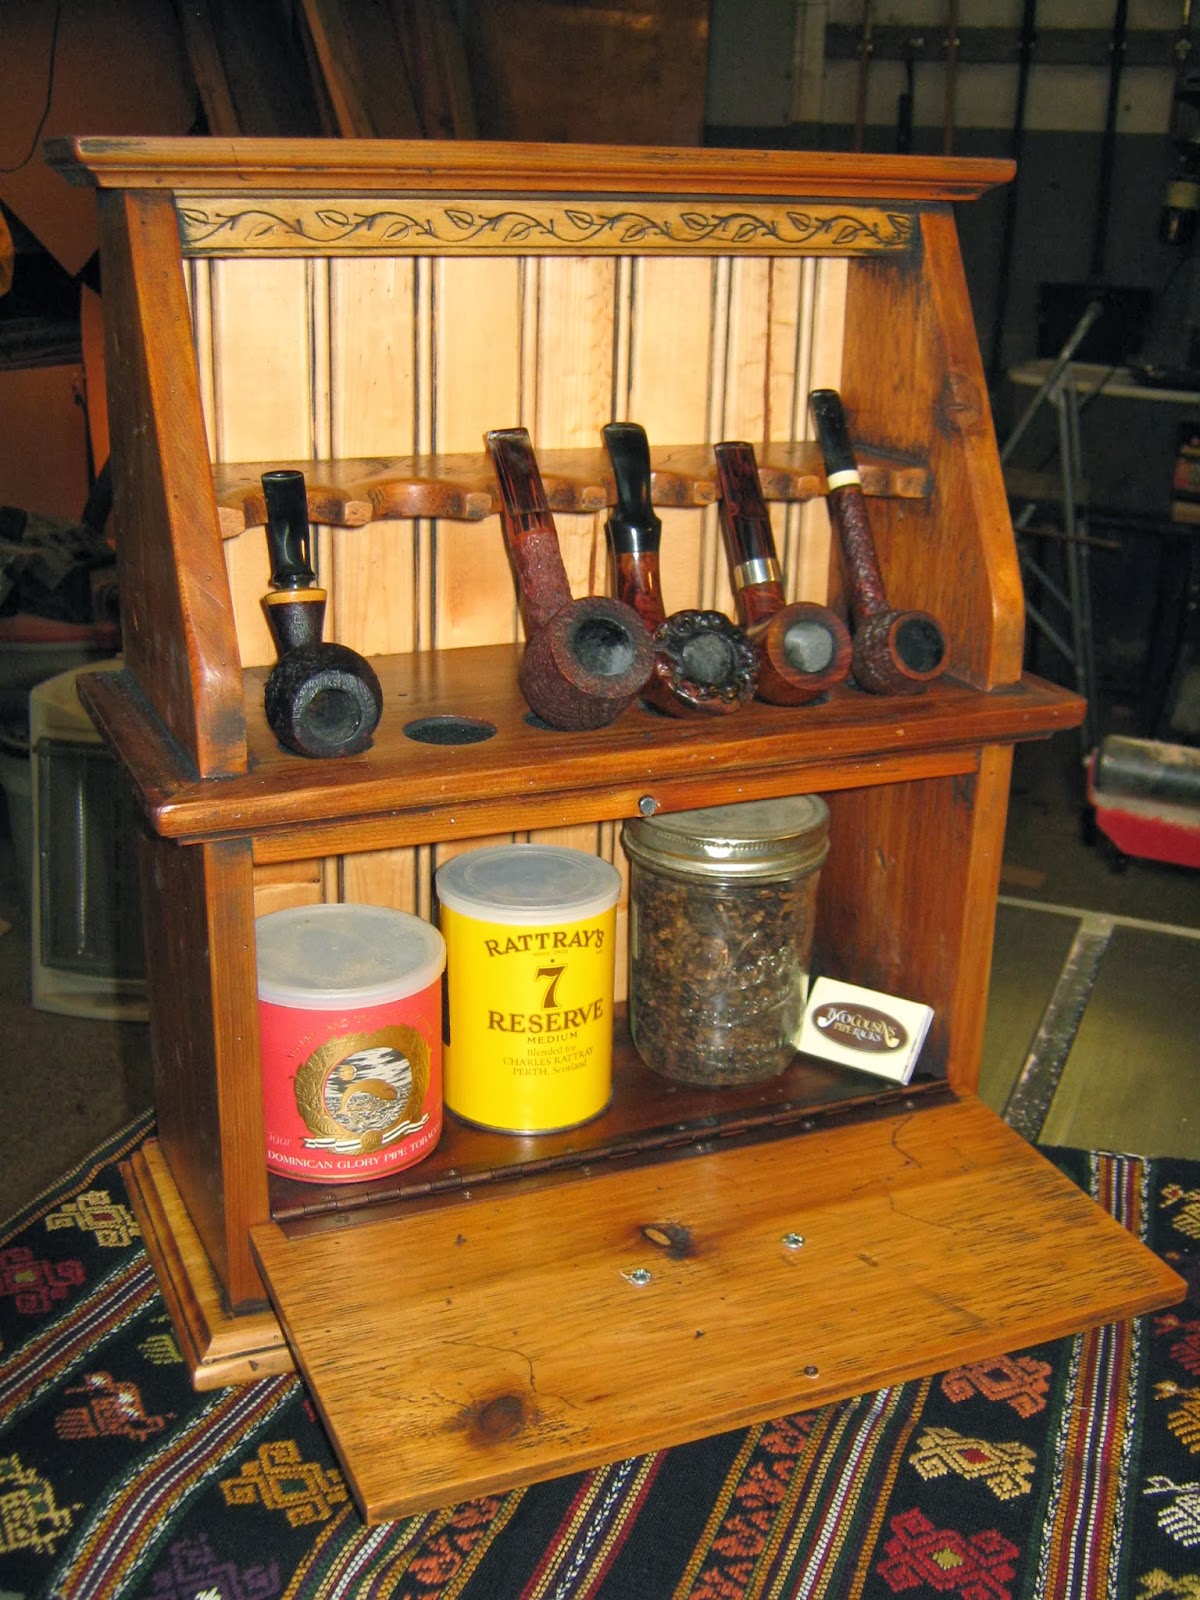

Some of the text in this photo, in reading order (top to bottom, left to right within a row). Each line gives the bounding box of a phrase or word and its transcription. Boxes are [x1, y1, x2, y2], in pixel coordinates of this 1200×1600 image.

[484, 928, 604, 957] RATTRAY'S
[534, 963, 568, 1011] 7
[488, 998, 604, 1033] RESERVE
[527, 1031, 578, 1044] MEDIUM
[503, 1046, 593, 1066] CHARLES RATTRAY
[527, 1044, 576, 1057] Blended for
[513, 1059, 587, 1076] PERTH, Scotland
[267, 1150, 333, 1169] DOMINICAN
[337, 1156, 381, 1169] GLORY
[383, 1147, 408, 1163] PIPE
